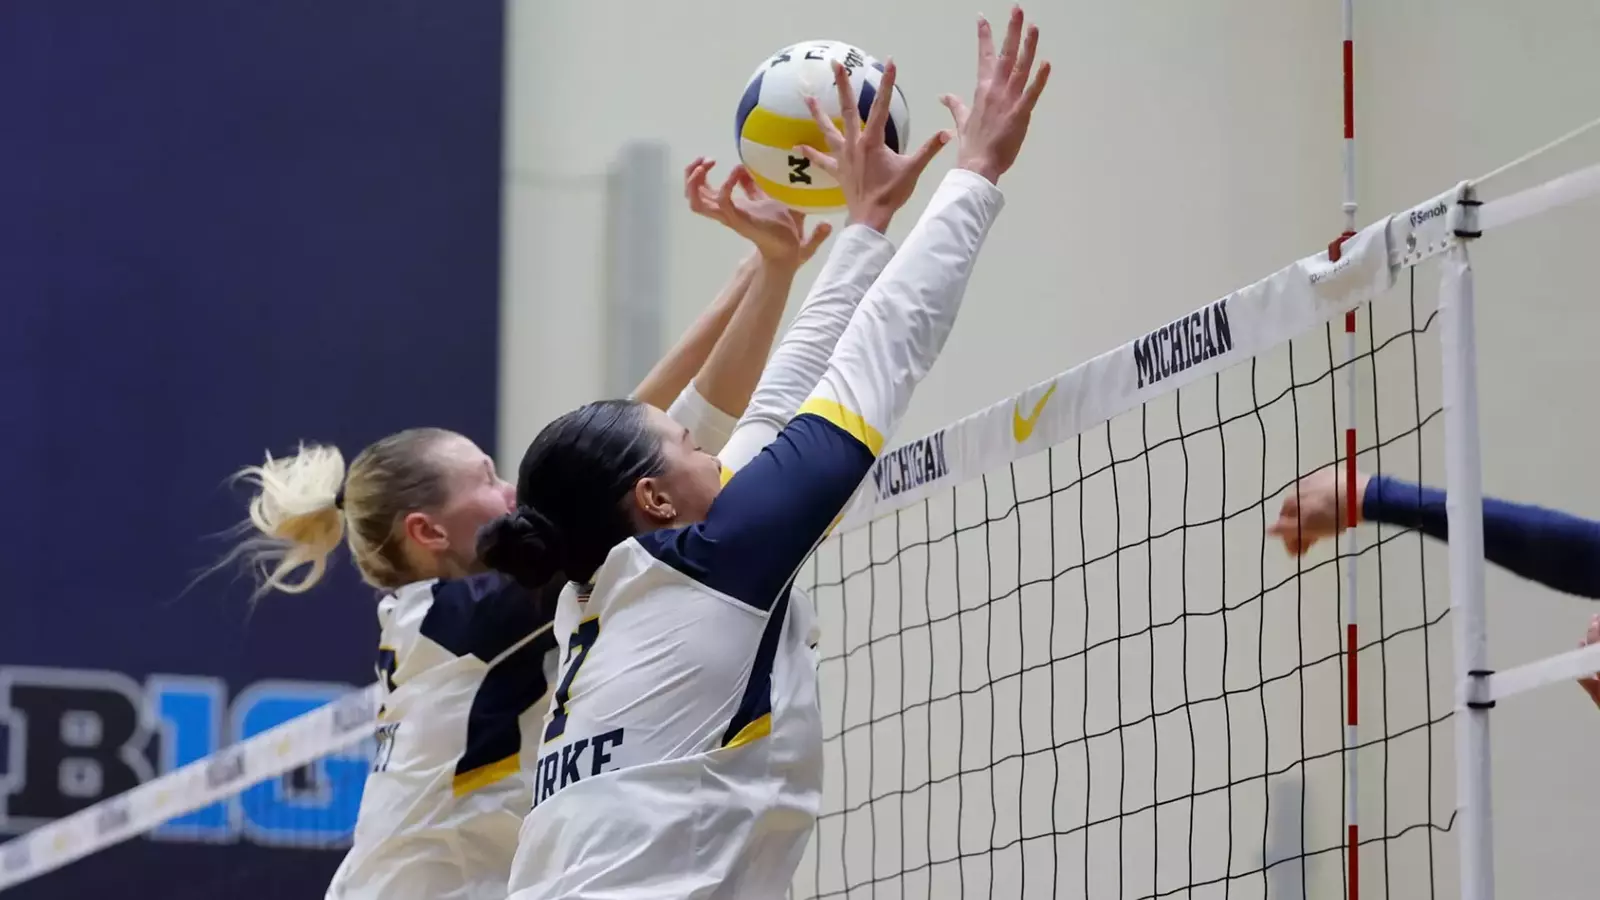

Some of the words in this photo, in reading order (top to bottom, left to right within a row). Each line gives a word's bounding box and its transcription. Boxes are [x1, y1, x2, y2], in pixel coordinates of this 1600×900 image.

[788, 155, 812, 185] M
[1416, 202, 1447, 226] Senoh
[1134, 299, 1233, 389] MICHIGAN
[873, 429, 949, 503] MICHIGAN
[544, 614, 601, 744] 7
